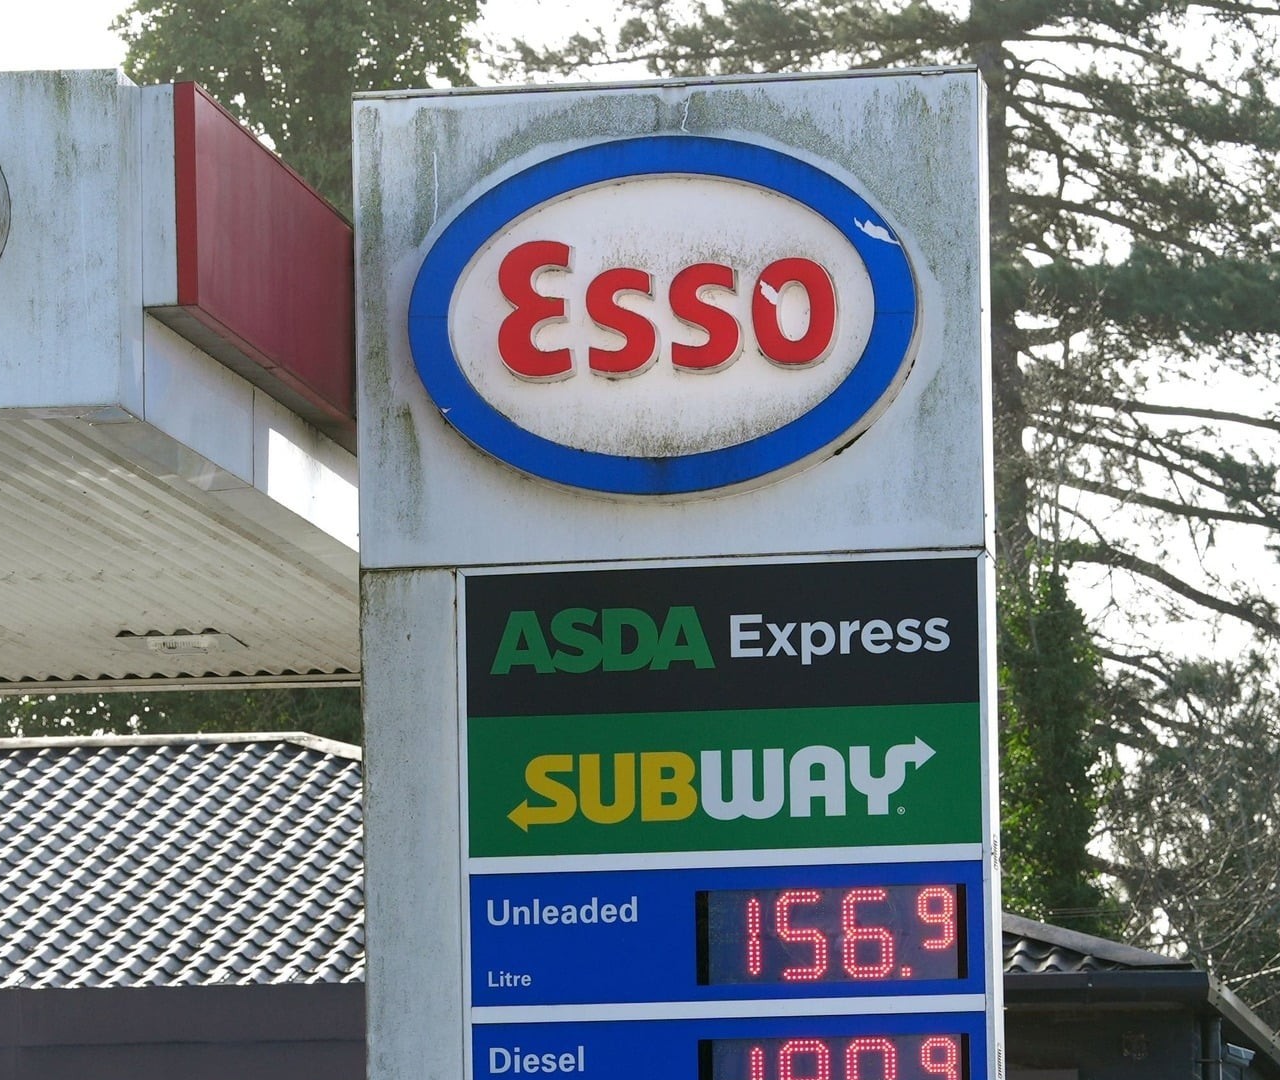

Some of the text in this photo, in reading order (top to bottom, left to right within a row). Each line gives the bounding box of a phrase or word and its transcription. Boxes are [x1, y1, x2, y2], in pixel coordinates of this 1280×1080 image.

[497, 239, 837, 380] Esso
[489, 605, 952, 675] ASDA Express
[506, 735, 938, 834] SUBWAY
[486, 896, 639, 927] Unleaded
[746, 886, 954, 981] 156.9
[486, 970, 533, 988] Litre
[488, 1046, 586, 1075] Diesel
